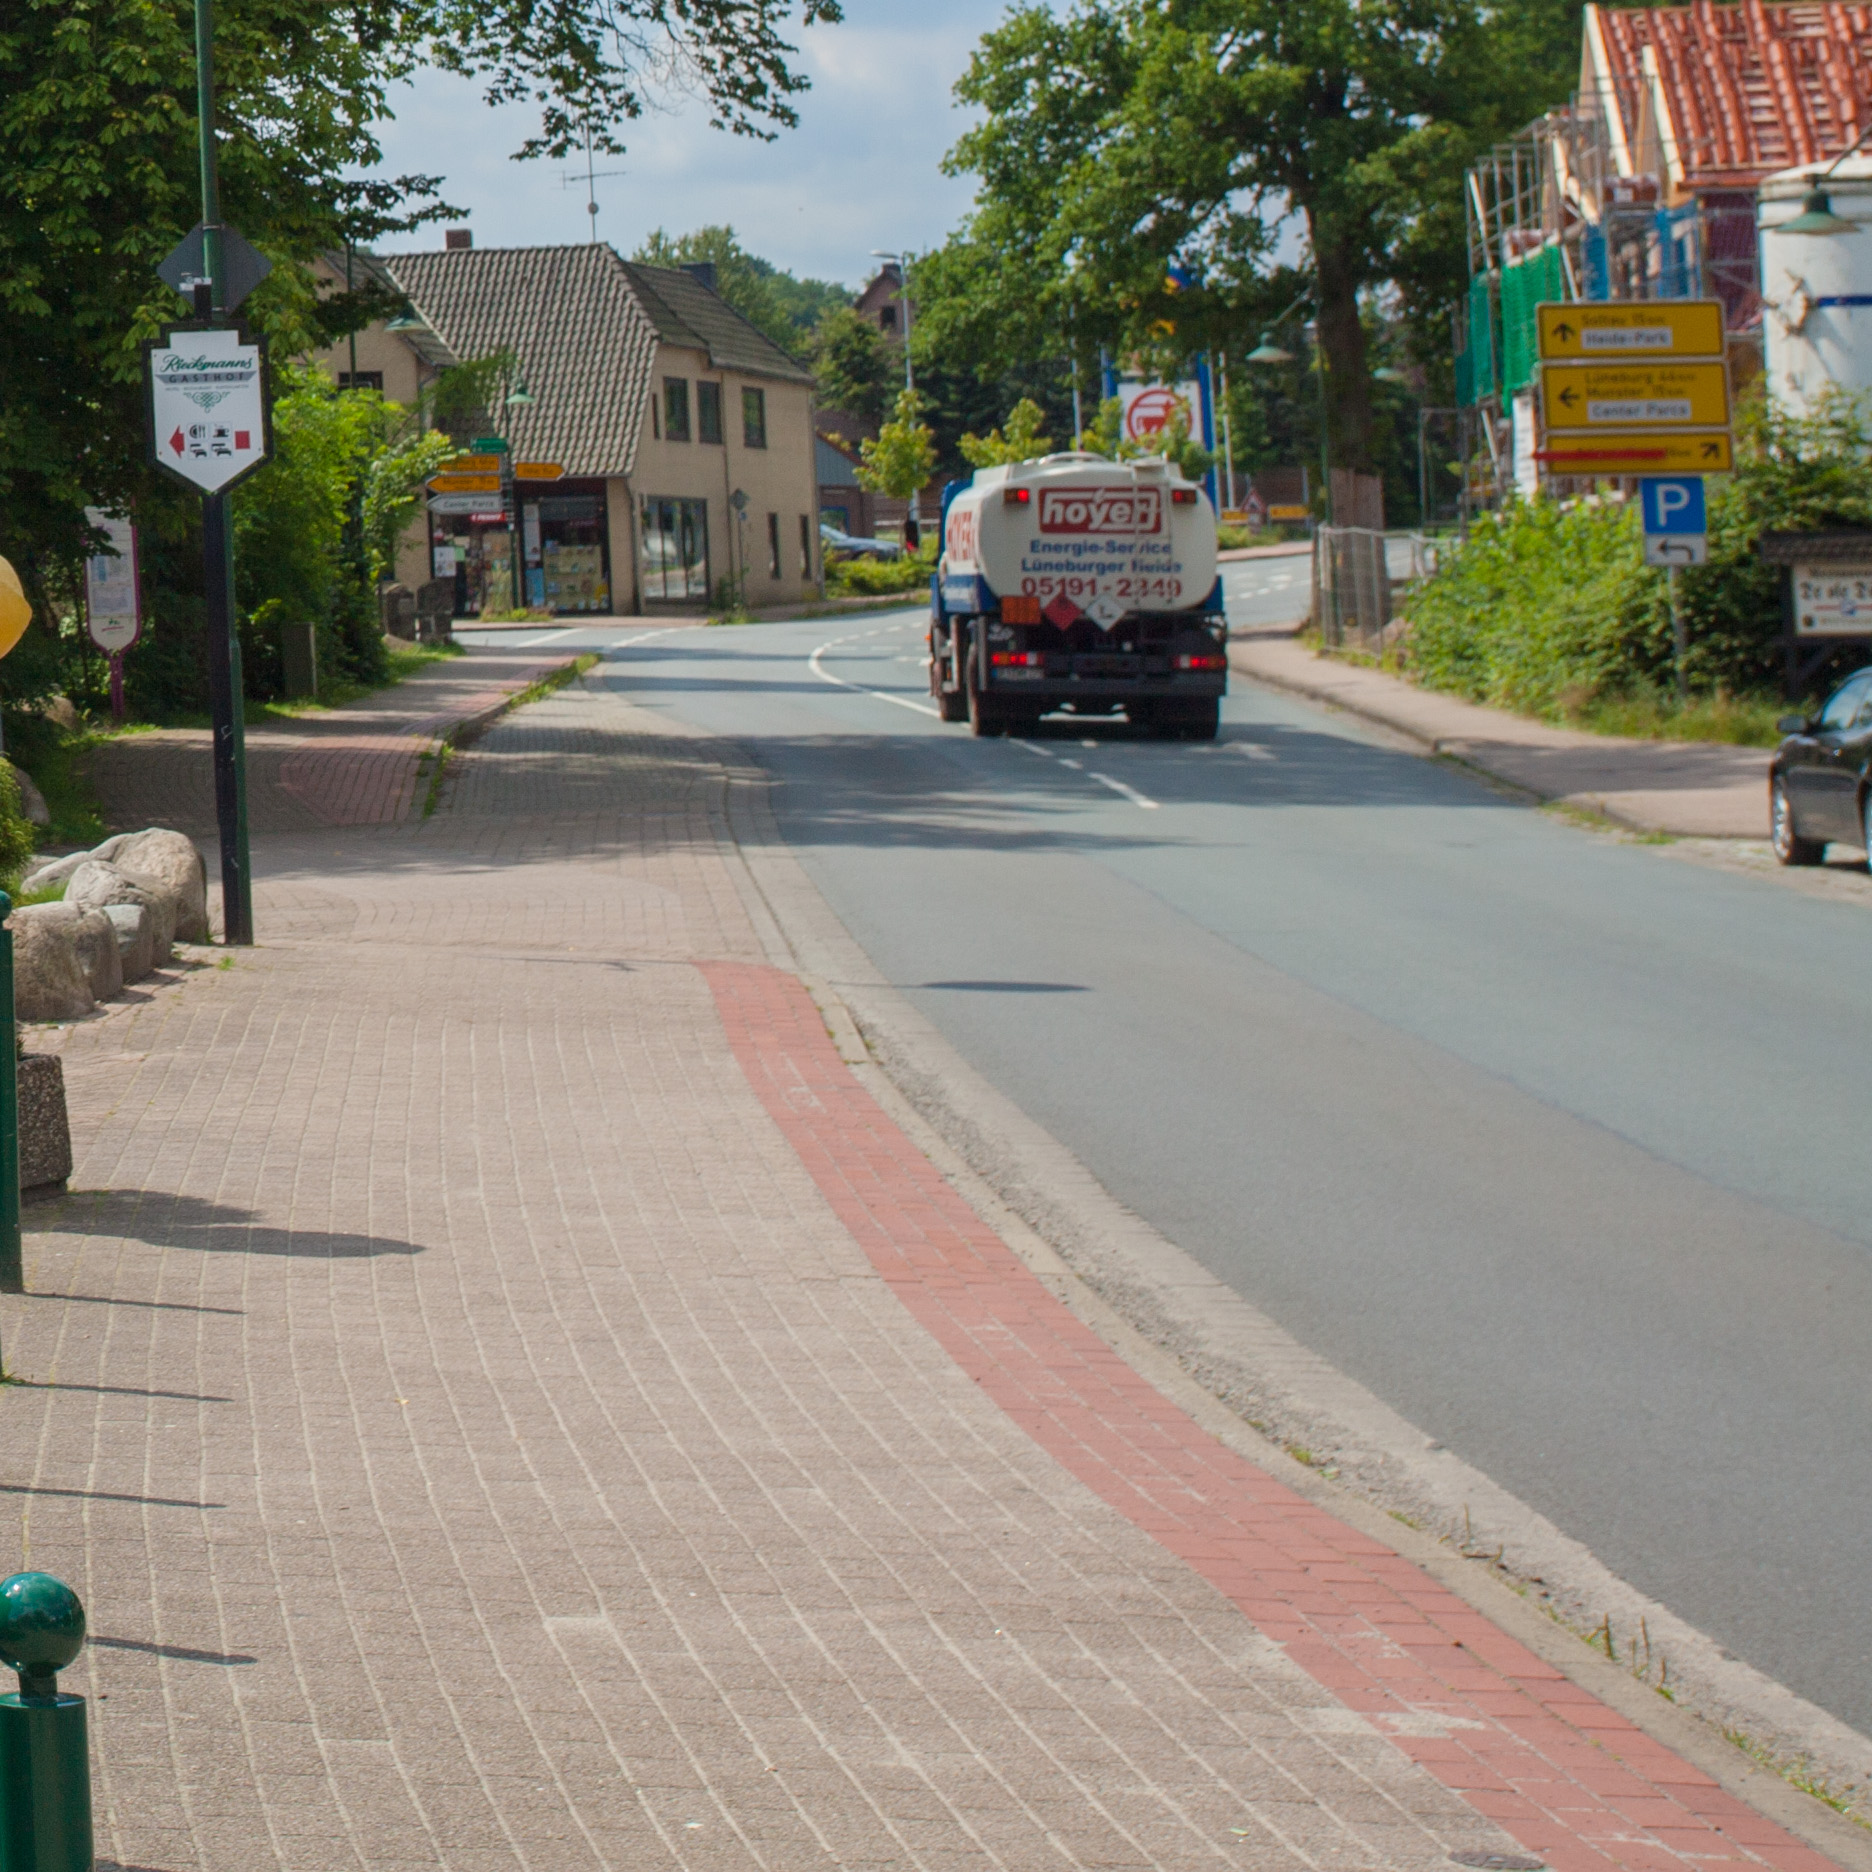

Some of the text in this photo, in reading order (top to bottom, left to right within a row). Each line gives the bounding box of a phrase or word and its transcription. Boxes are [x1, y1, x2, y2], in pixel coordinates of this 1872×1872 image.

[160, 354, 253, 373] Rieckmanns
[168, 372, 244, 383] GASTHOF
[1592, 405, 1640, 418] Center
[1042, 489, 1158, 531] hoyer
[1656, 483, 1690, 527] P
[1021, 558, 1125, 576] Lüneburger
